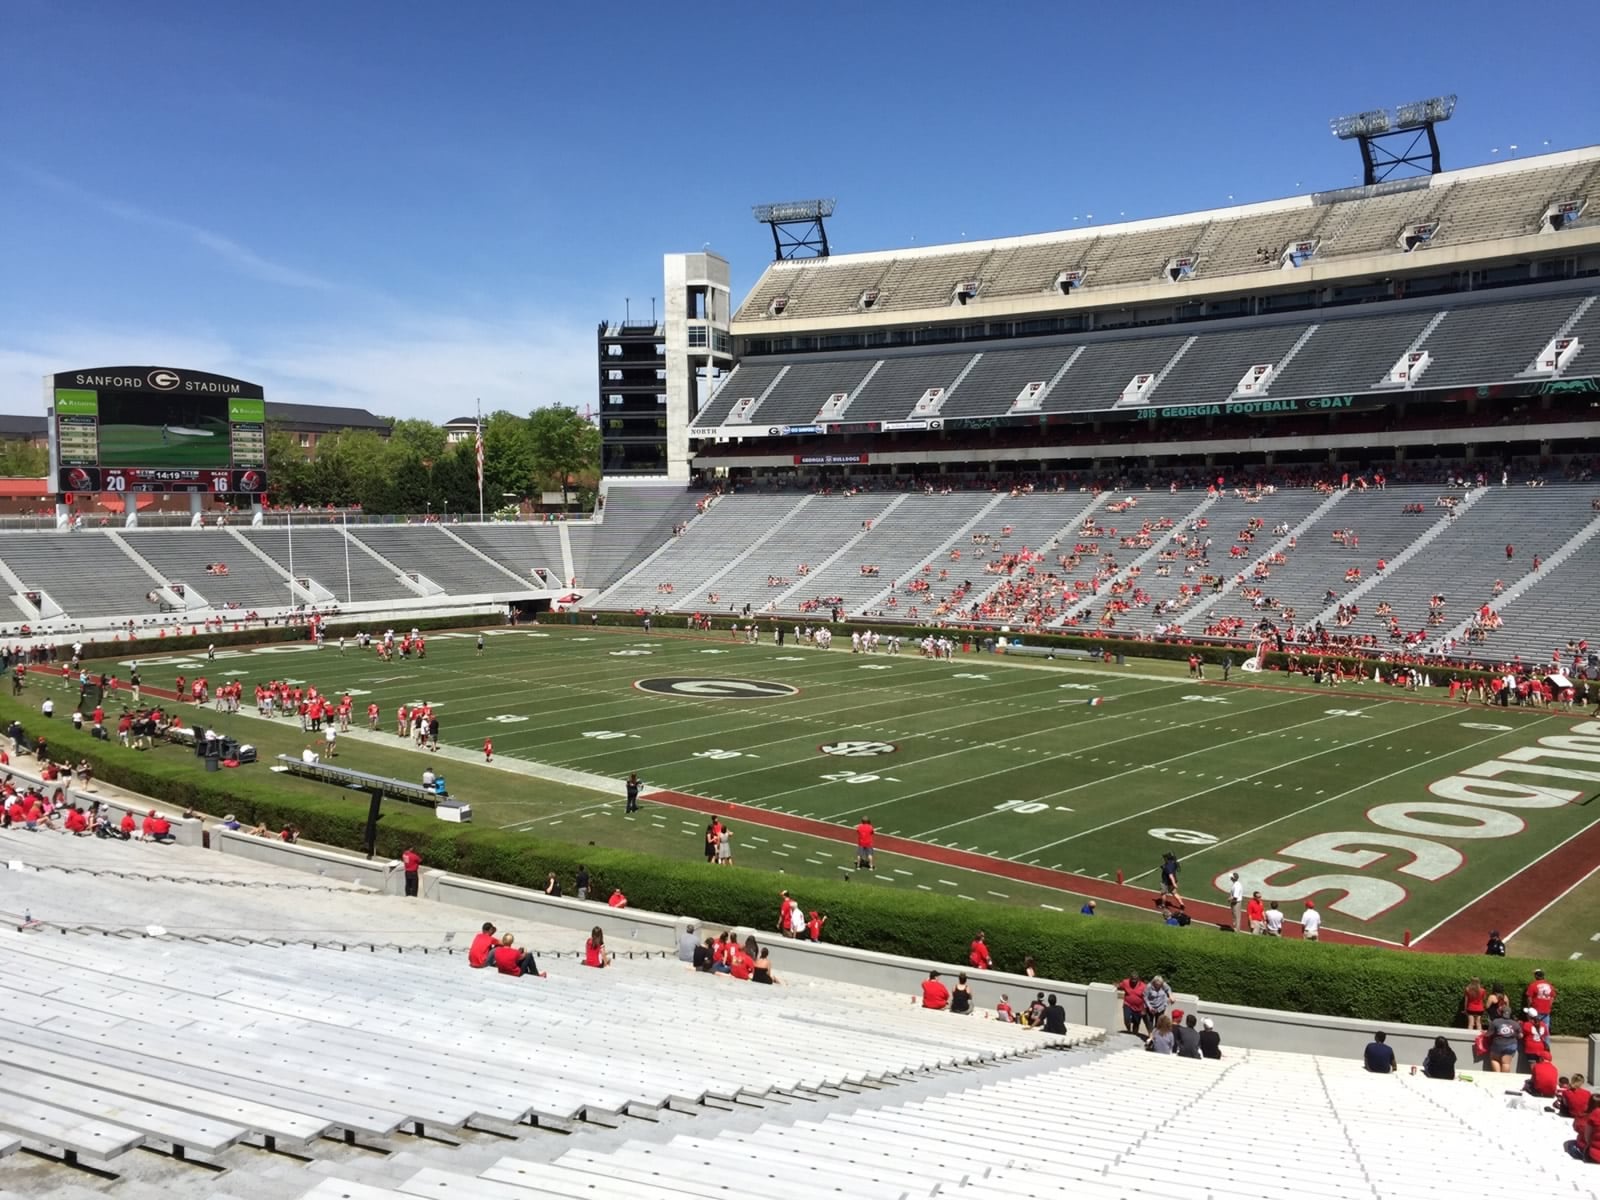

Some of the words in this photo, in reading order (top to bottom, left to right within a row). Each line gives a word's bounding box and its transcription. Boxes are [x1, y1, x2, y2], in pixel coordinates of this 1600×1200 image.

[76, 374, 142, 388] SANFORD
[185, 381, 240, 393] STADIUM
[1137, 409, 1157, 419] 2015
[1162, 405, 1221, 417] GEORGIA
[1226, 400, 1298, 414] FOOTBALL
[1321, 396, 1354, 408] DAY
[156, 471, 180, 479] 14:19
[107, 476, 125, 491] 20
[212, 477, 228, 492] 16
[117, 629, 538, 666] GEORIA
[692, 748, 742, 760] 30
[820, 771, 880, 783] 20
[993, 800, 1050, 814] 10
[1213, 720, 1600, 921] LLDOGS
